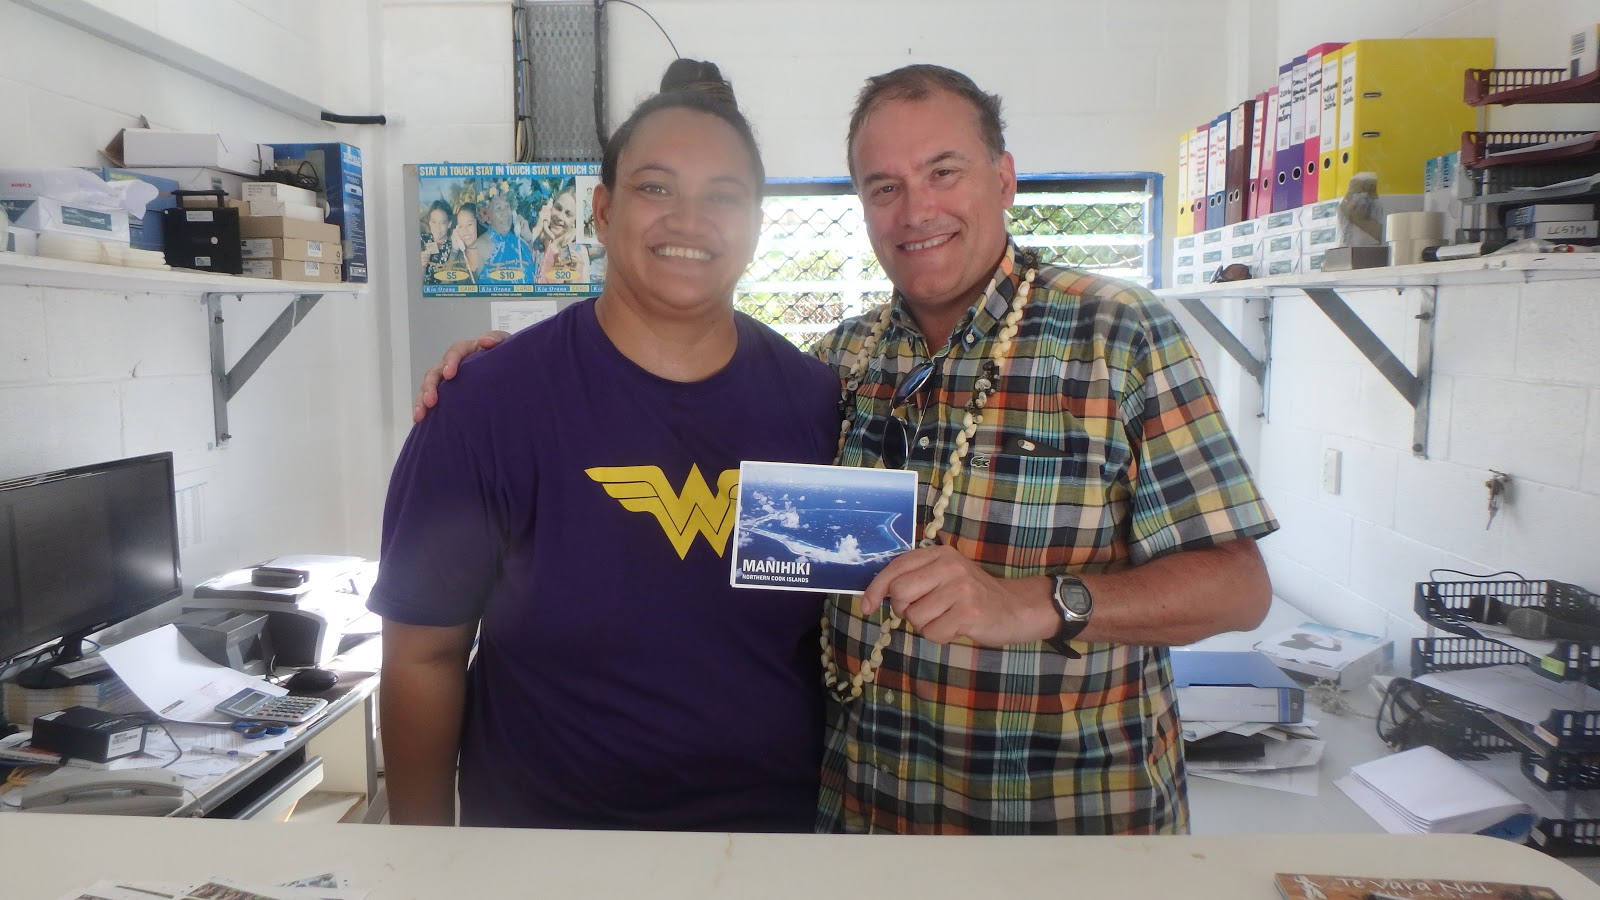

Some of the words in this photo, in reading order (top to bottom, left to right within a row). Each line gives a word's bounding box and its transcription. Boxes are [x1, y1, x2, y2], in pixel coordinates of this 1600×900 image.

[420, 166, 437, 176] STAY
[440, 166, 448, 176] IN
[450, 166, 474, 176] TOUCH
[476, 166, 493, 176] STAY
[496, 166, 504, 176] IN
[506, 165, 530, 175] TOUCH
[532, 165, 550, 175] STAY
[552, 165, 560, 175] IN
[562, 165, 586, 175] TOUCH
[446, 271, 457, 280] $5
[500, 271, 515, 280] $10
[555, 271, 571, 280] $20
[743, 559, 811, 575] MANIHIKI
[1338, 878, 1364, 889] Te
[1370, 879, 1430, 892] Vara
